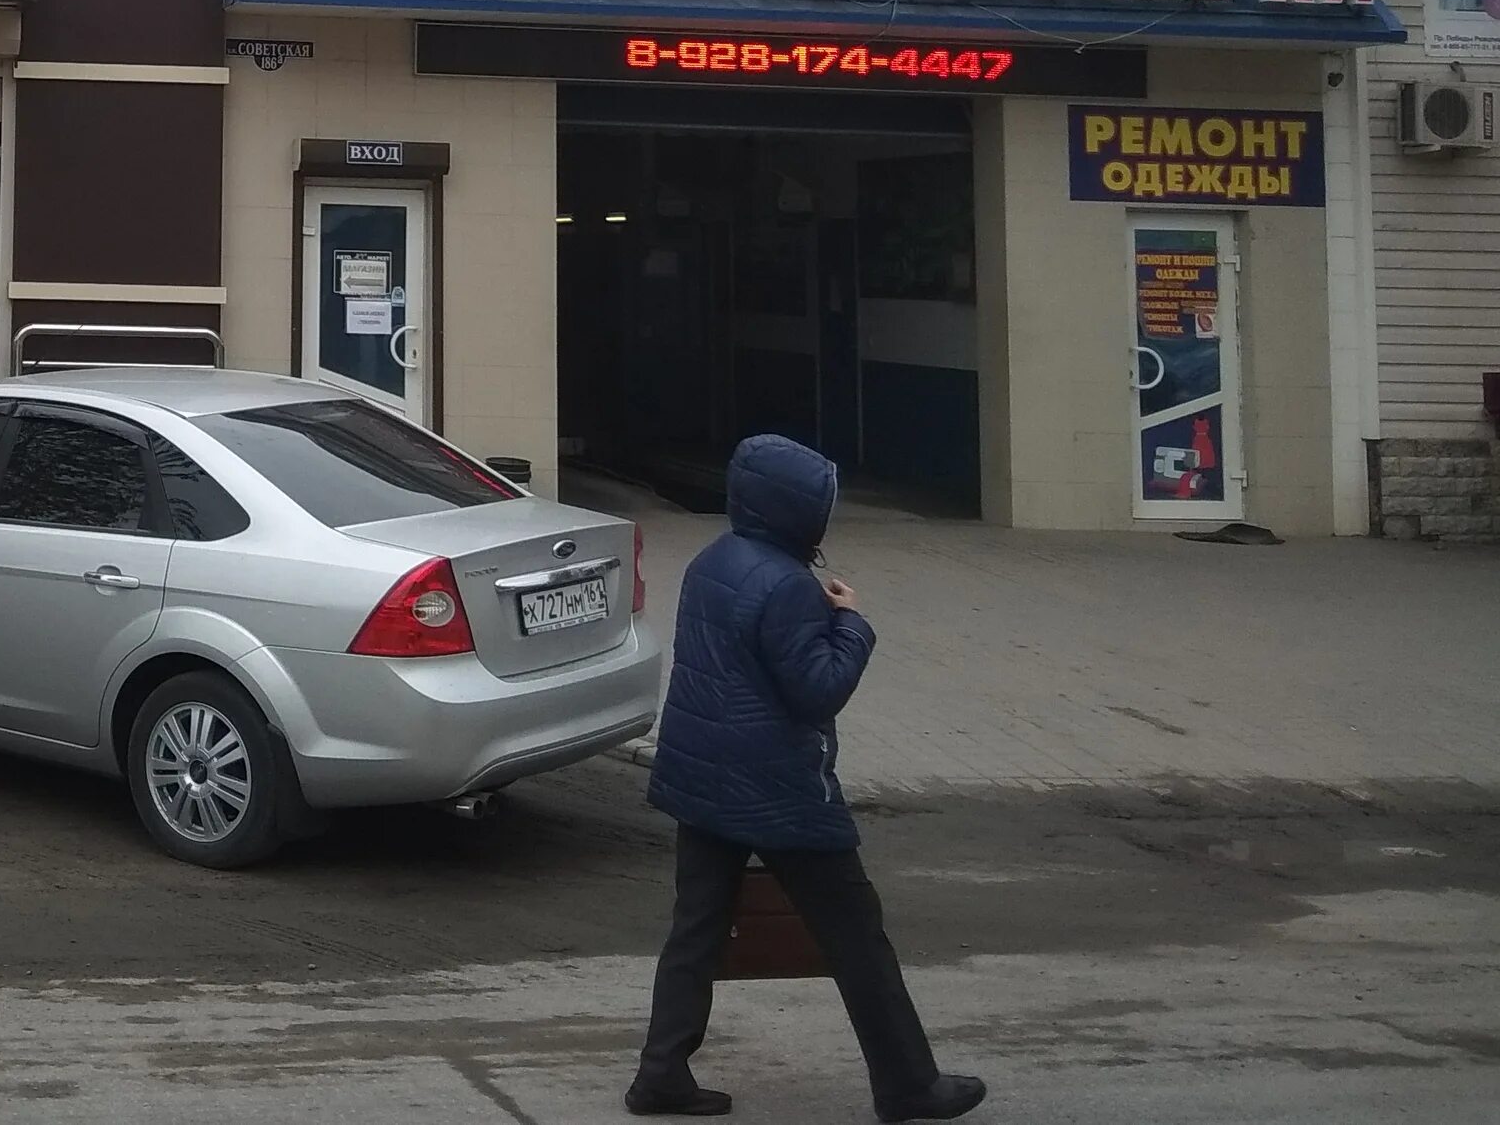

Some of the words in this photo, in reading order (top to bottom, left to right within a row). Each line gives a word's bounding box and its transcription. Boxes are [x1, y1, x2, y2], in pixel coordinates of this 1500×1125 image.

[238, 42, 310, 57] СОВЕТСКАЯ
[626, 39, 1013, 79] 8-928-174-4447
[1084, 114, 1307, 159] РЕМОНТ
[350, 145, 400, 162] ВХОД
[1102, 161, 1291, 200] ОДЕЖДЫ
[343, 265, 385, 274] МАГАЗИН
[584, 581, 602, 604] 161
